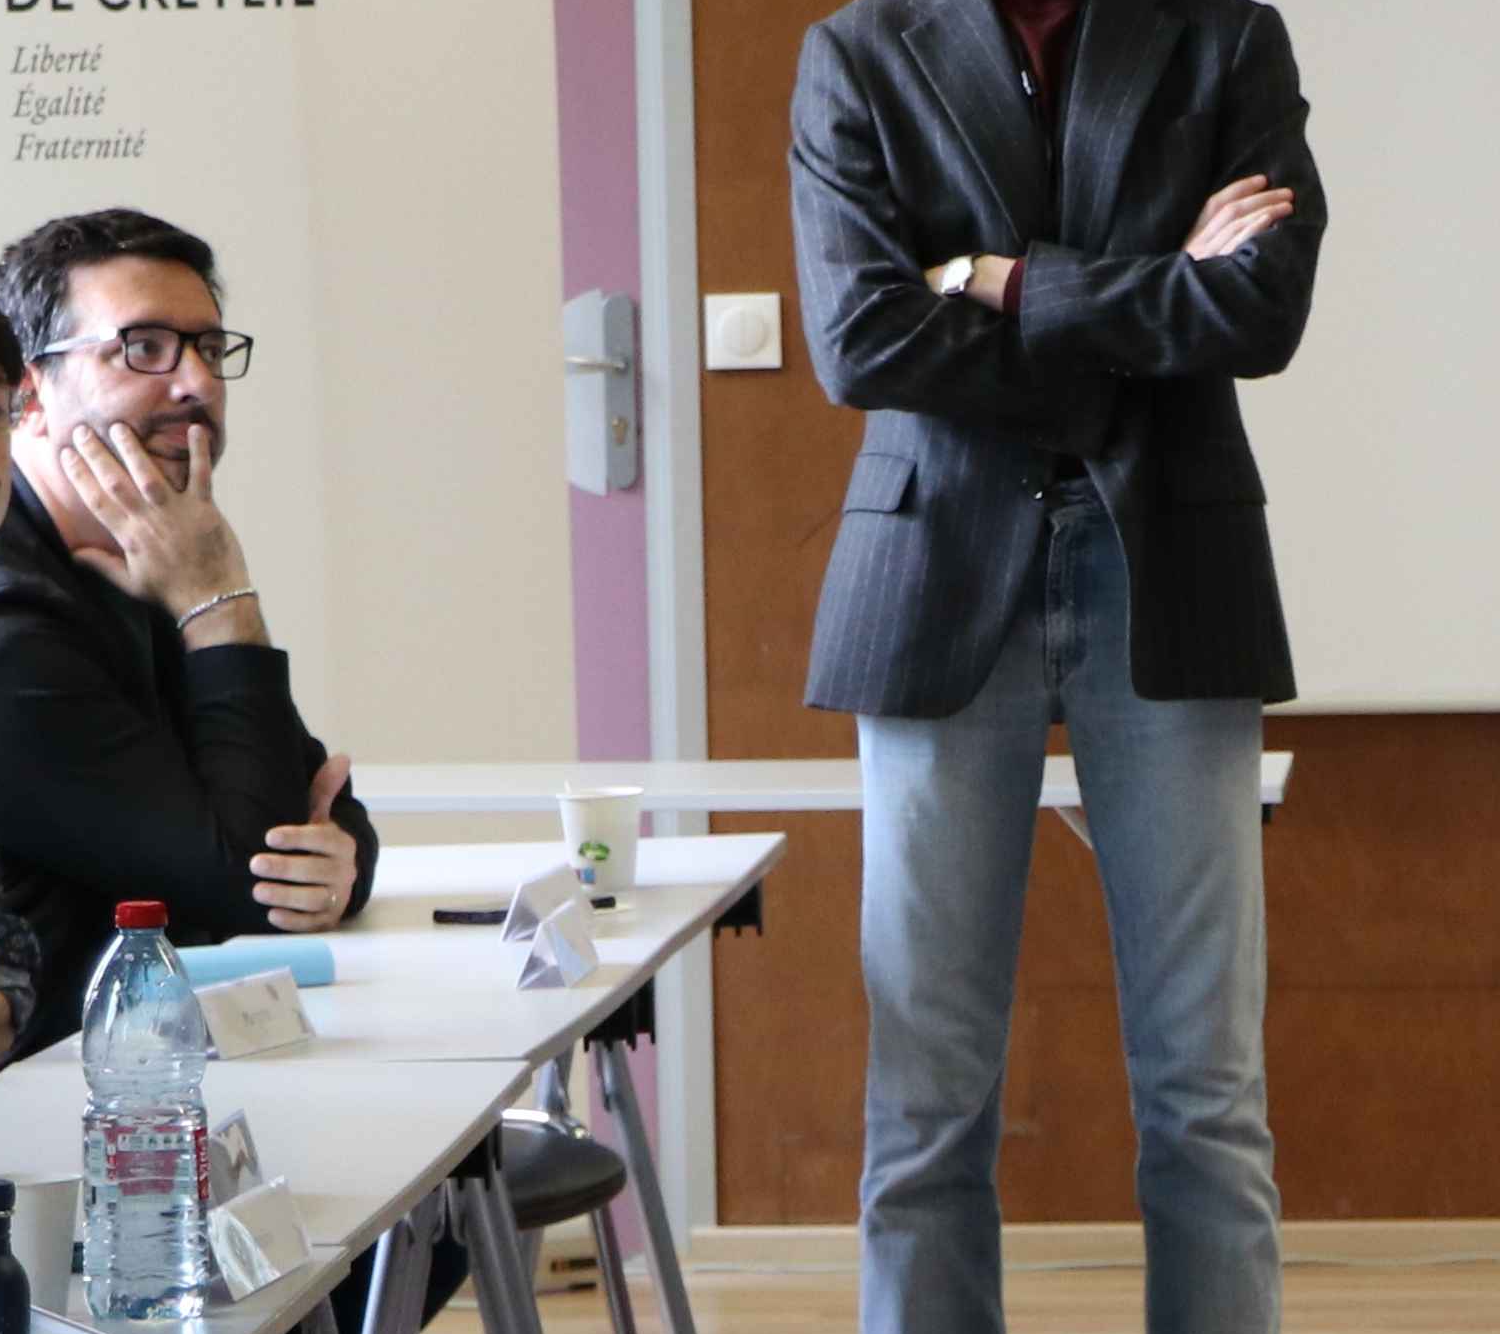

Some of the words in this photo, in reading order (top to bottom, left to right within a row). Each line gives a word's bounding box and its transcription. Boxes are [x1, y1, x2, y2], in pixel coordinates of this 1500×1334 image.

[11, 44, 102, 74] Liberté
[12, 86, 105, 125] Égalité
[15, 130, 145, 161] Fraternité
